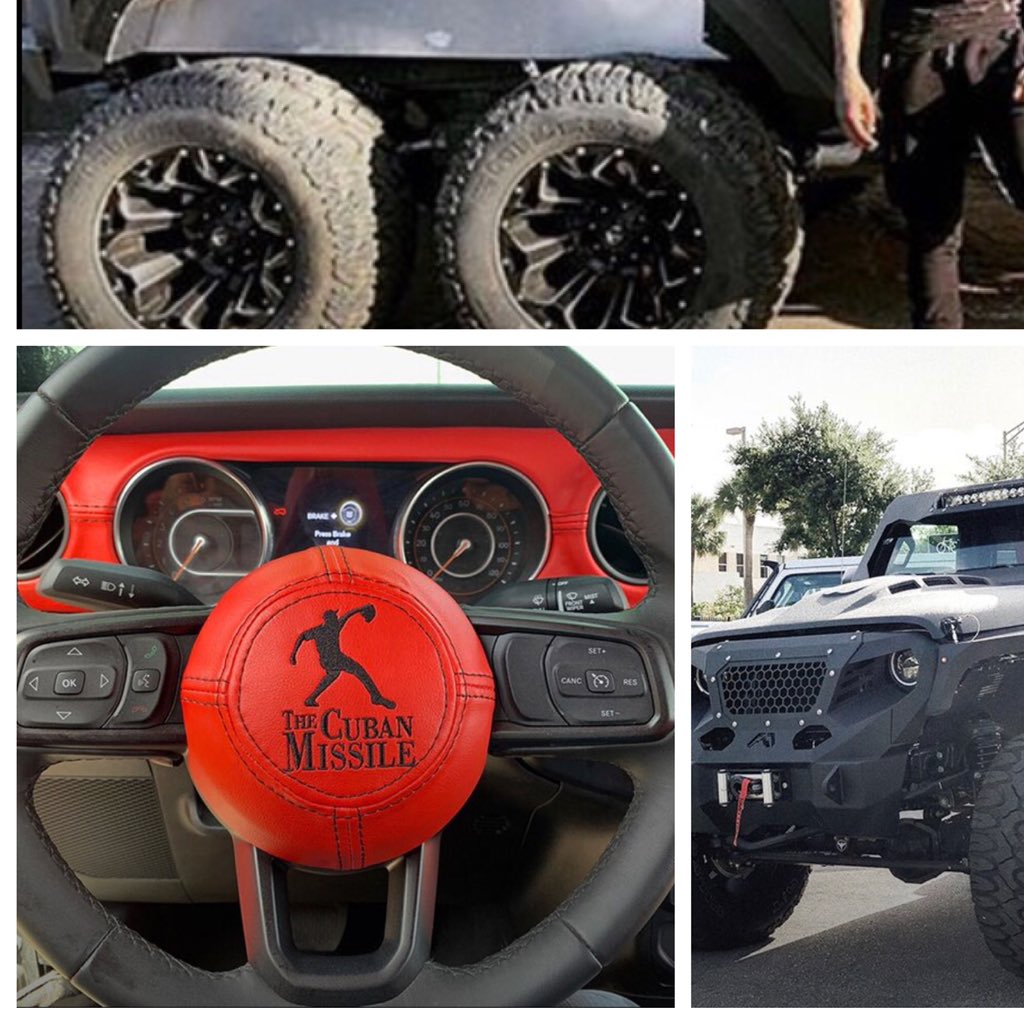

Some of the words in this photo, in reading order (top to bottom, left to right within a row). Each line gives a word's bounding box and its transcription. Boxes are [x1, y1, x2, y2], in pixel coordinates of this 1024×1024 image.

[307, 512, 329, 520] BRAKE
[62, 679, 77, 688] OK
[282, 709, 317, 730] THE
[321, 708, 413, 741] CUBAN
[283, 731, 416, 772] MISSILE
